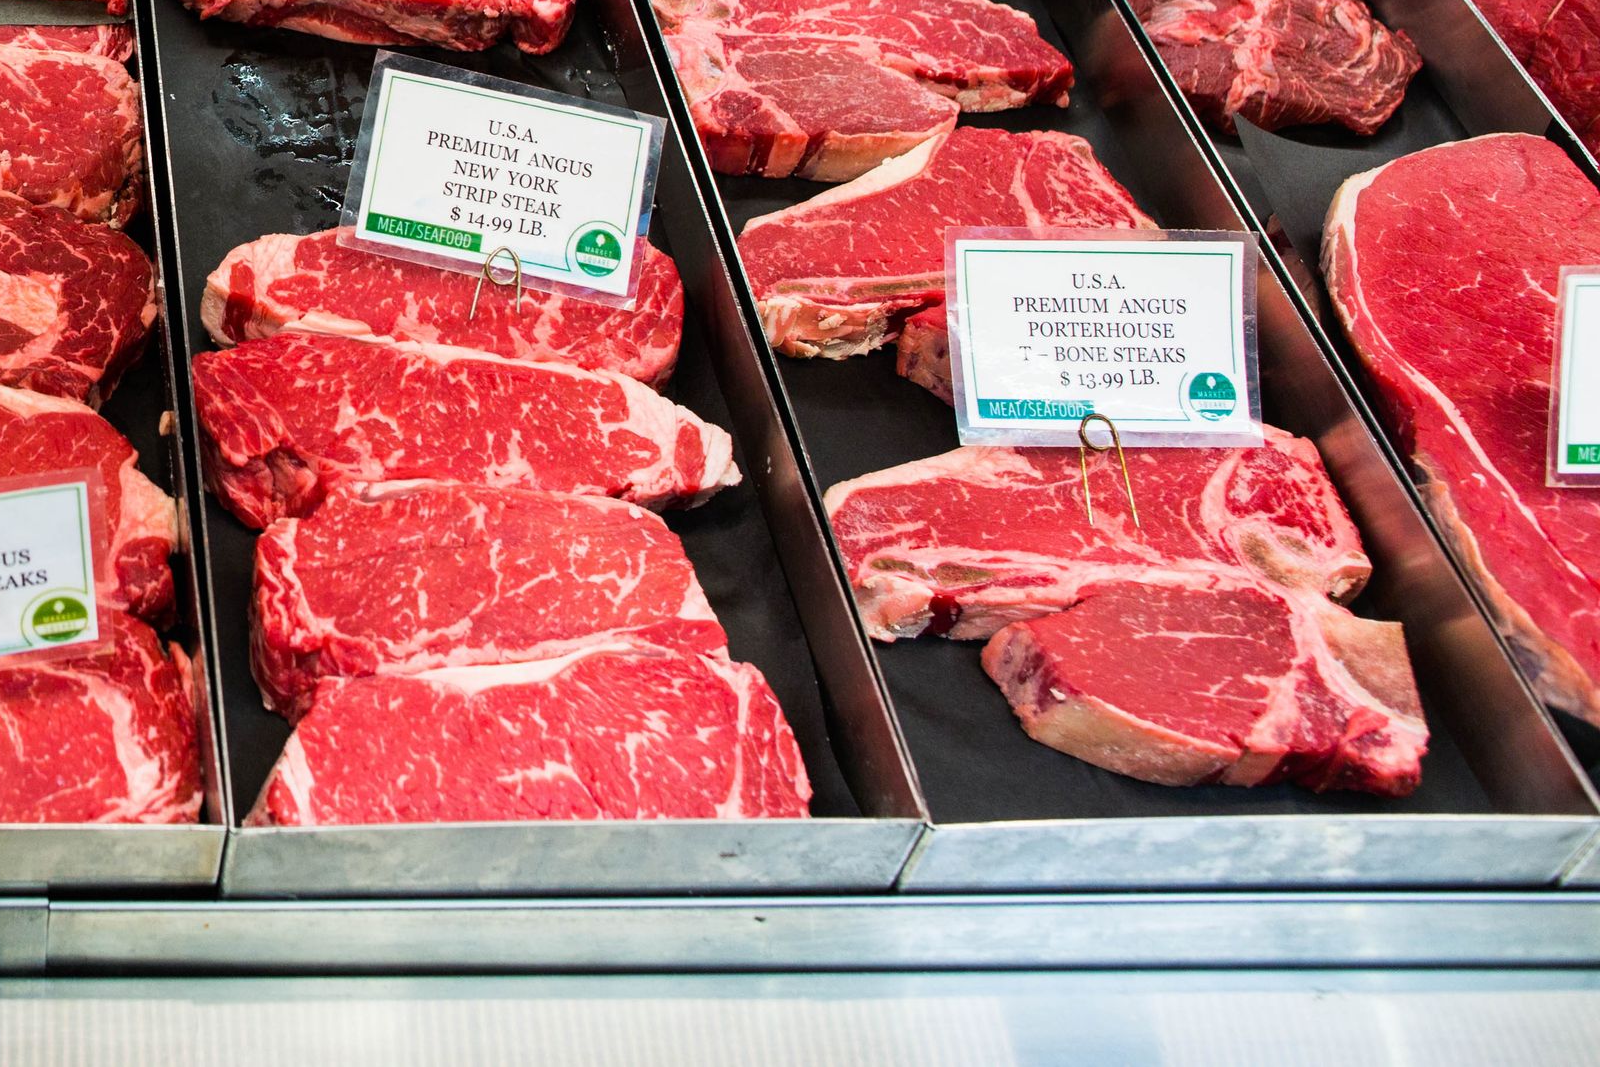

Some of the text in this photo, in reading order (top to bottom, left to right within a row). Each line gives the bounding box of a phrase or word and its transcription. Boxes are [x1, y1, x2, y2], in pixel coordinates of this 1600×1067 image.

[489, 119, 539, 144] U.S.A.
[427, 130, 593, 178] PREMIUM ANGUS
[453, 160, 559, 195] NEW YORK
[443, 182, 562, 219] STRIP STEAK
[378, 217, 472, 249] MEAT/SEAFOOD
[450, 207, 547, 238] $ 14.99 LB.
[1072, 274, 1125, 289] U.S.A.
[1013, 297, 1187, 314] PREMIUM ANGUS
[1028, 322, 1175, 339] PORTERHOUSE
[1019, 346, 1032, 361] T
[1054, 346, 1108, 362] BONE
[1113, 347, 1186, 363] STEAKS
[1061, 369, 1159, 389] $ 13.99 LB.
[989, 400, 1085, 418] MEAT/SEAFOOD
